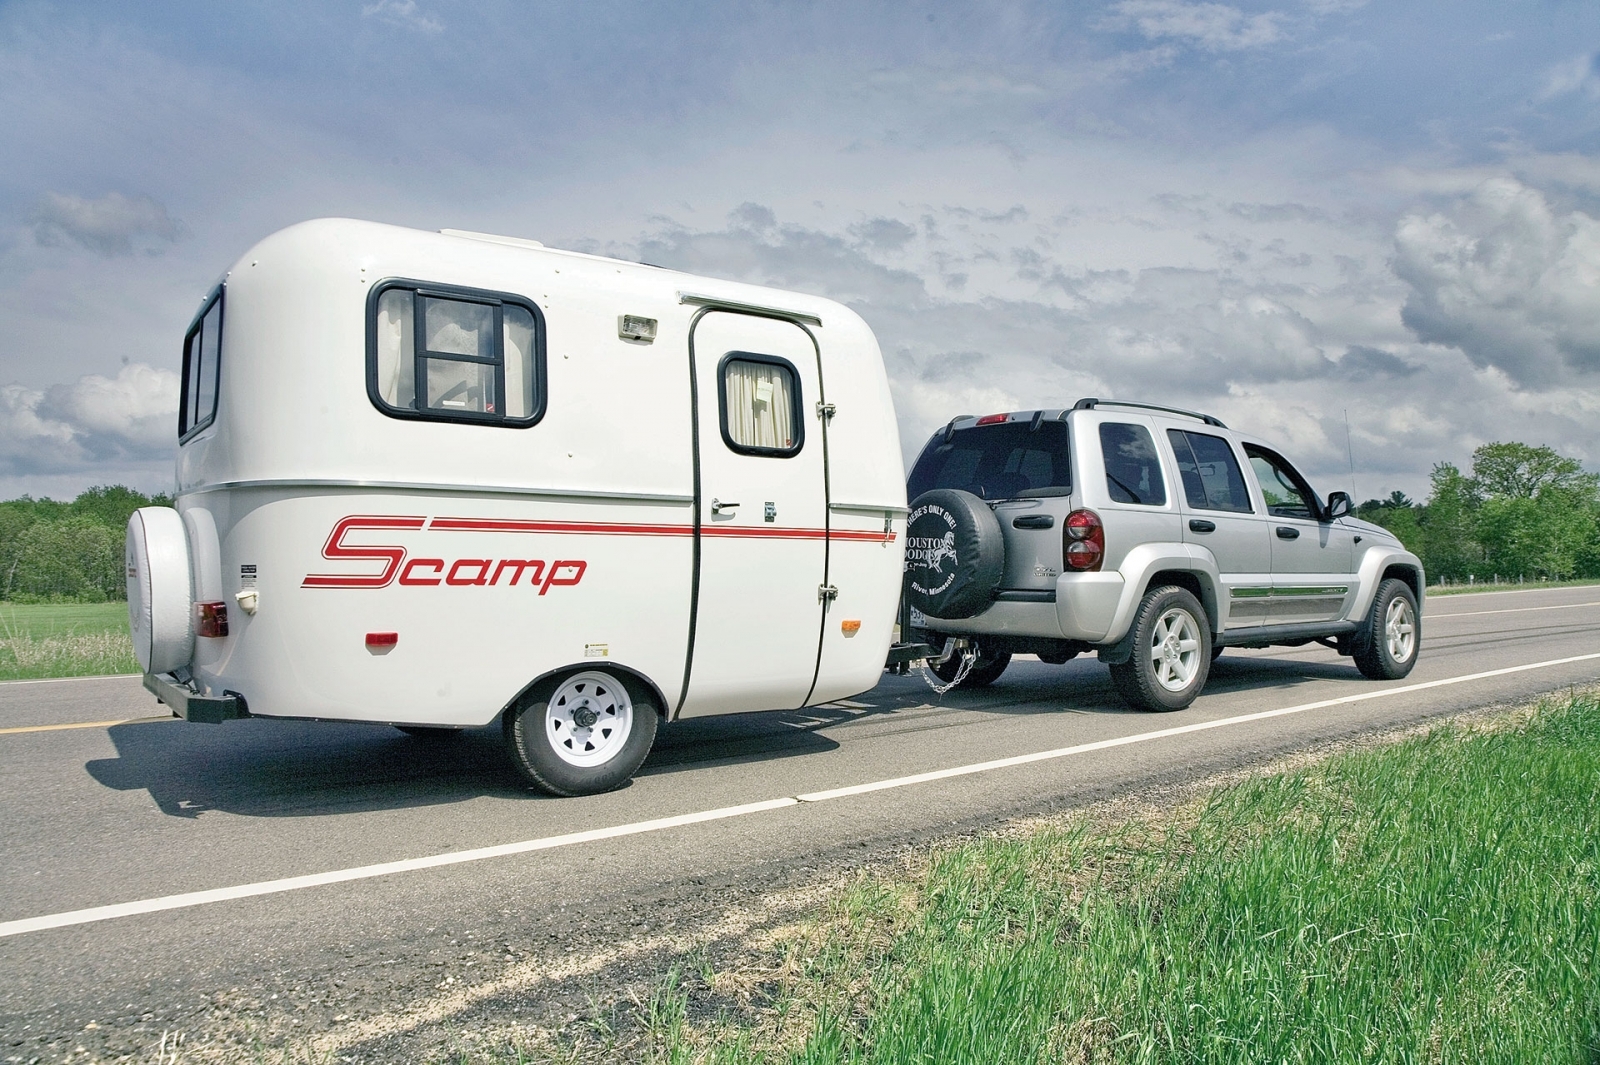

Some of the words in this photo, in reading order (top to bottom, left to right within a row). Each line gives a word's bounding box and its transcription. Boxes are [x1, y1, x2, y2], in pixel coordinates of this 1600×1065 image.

[928, 504, 945, 516] ONLY
[943, 511, 957, 530] ONE!
[300, 514, 588, 596] Scamp
[911, 581, 929, 596] River,
[928, 572, 956, 596] Minnesota
